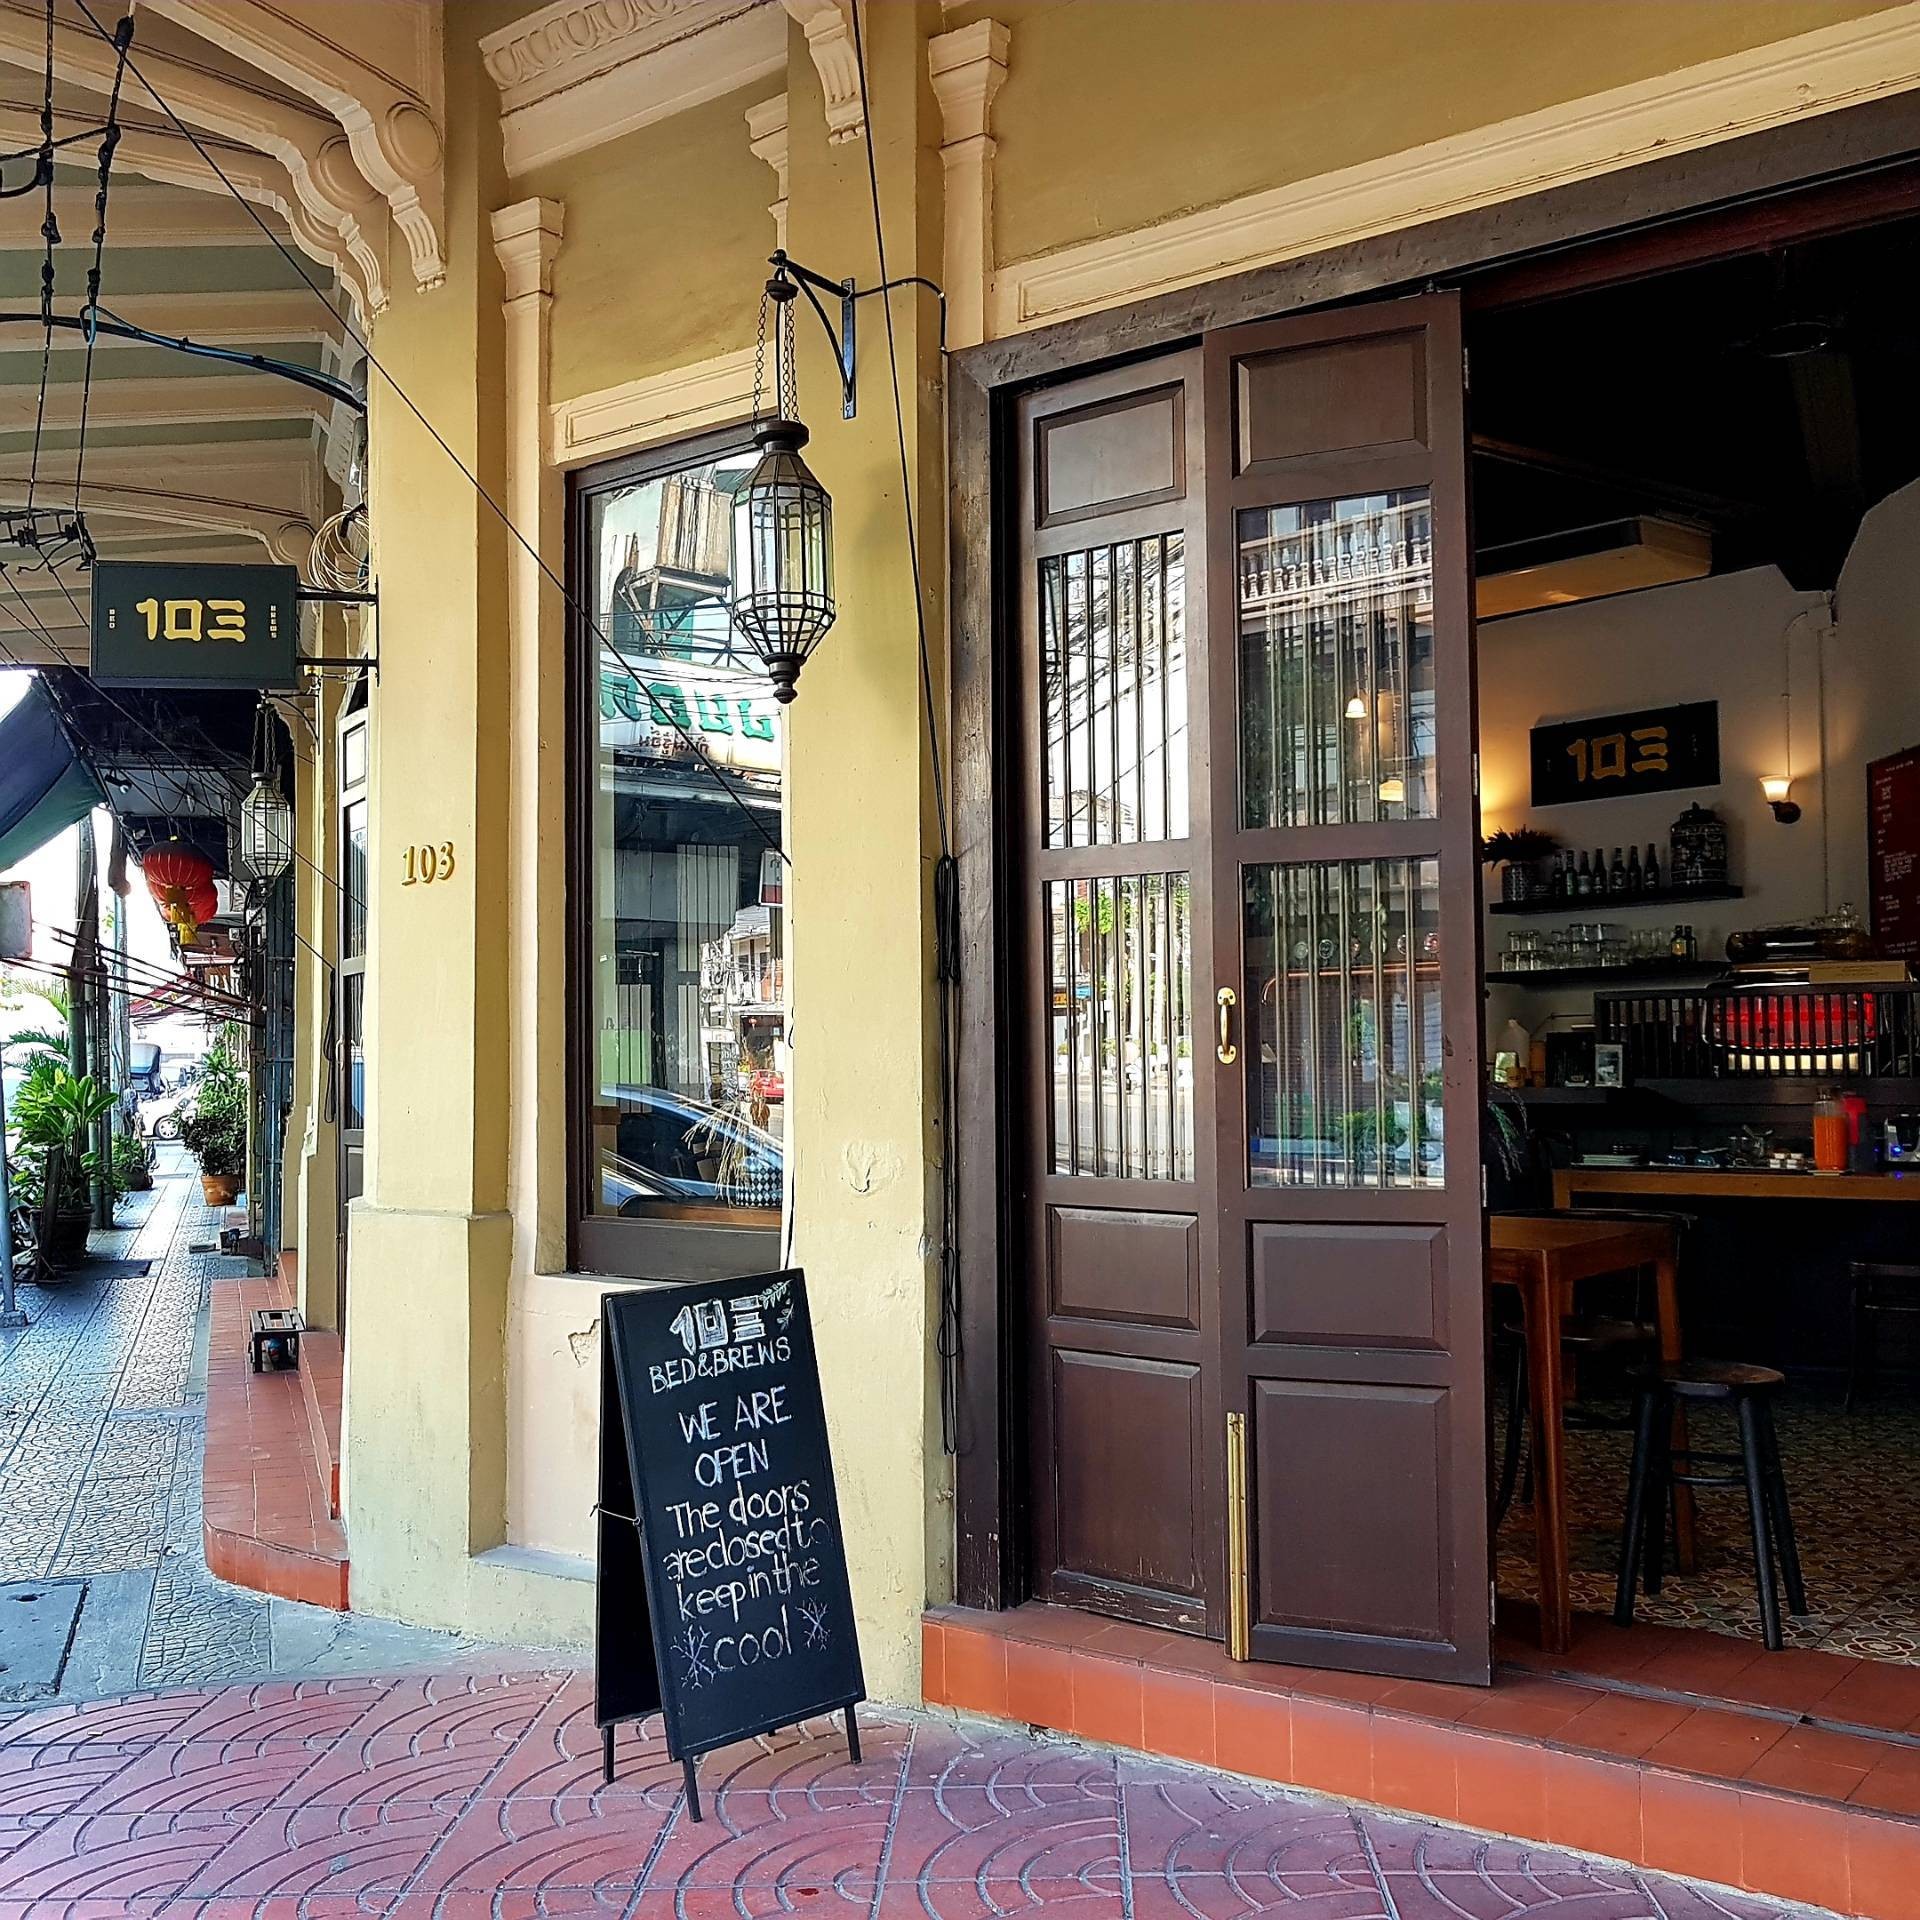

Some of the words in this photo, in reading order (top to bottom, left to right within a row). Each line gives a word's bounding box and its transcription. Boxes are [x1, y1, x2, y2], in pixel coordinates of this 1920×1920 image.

[401, 841, 456, 887] 103
[678, 1401, 721, 1444] WE
[735, 1385, 792, 1431] ARE
[694, 1438, 770, 1487] OPEN
[665, 1501, 722, 1538] The
[729, 1480, 810, 1527] doors
[676, 1583, 746, 1623] keep
[713, 1603, 792, 1671] cool
